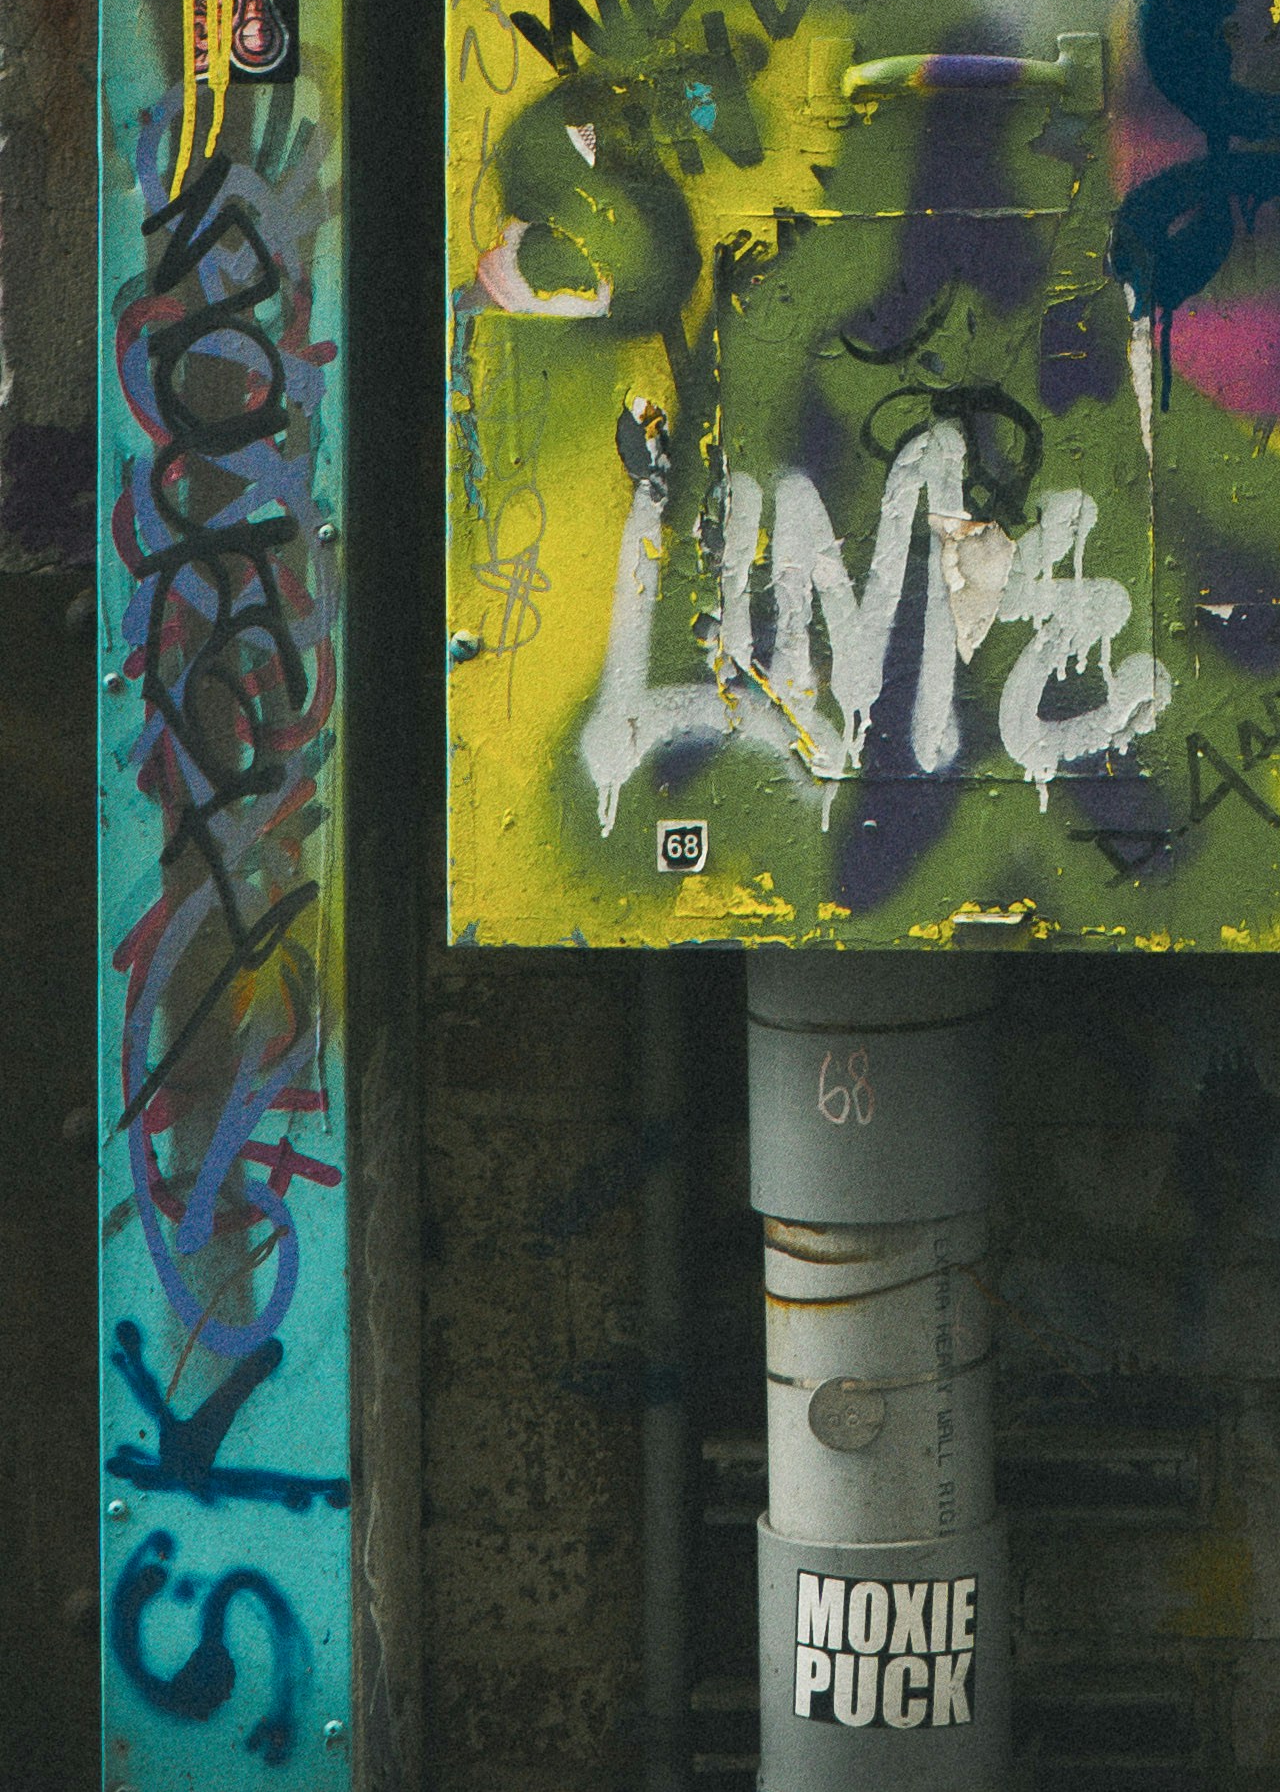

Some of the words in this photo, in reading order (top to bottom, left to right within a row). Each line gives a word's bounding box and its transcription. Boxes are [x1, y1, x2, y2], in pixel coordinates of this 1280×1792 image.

[667, 833, 700, 860] 68
[797, 1572, 978, 1656] MOXIE
[795, 1642, 974, 1728] PUCK
